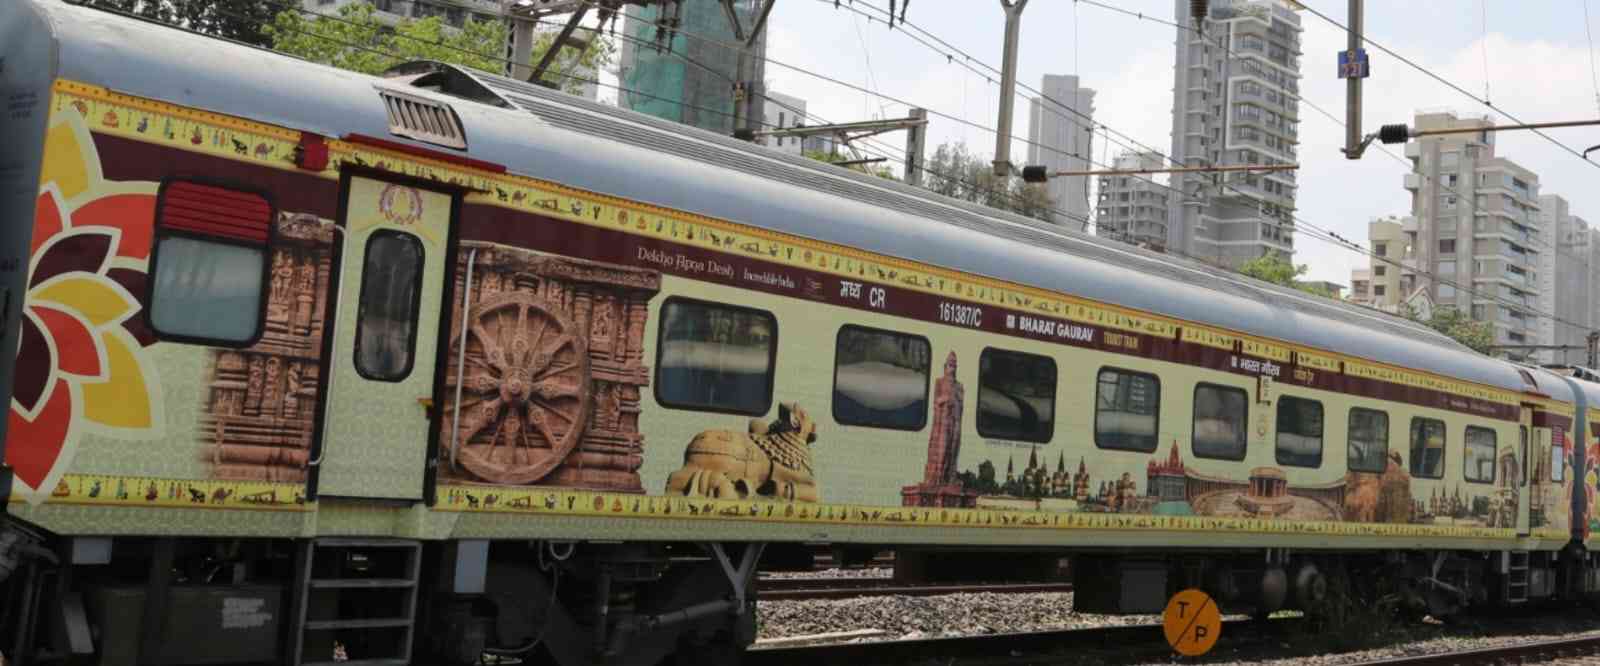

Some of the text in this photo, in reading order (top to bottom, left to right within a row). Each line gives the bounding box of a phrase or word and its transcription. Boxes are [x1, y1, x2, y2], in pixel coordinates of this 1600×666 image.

[638, 247, 673, 266] Dekho
[707, 260, 734, 279] Desh
[869, 287, 886, 308] CR
[938, 301, 983, 327] 161387/C
[1019, 316, 1094, 342] BHARAT GAURAV
[1177, 601, 1190, 618] T
[1194, 626, 1208, 642] P
